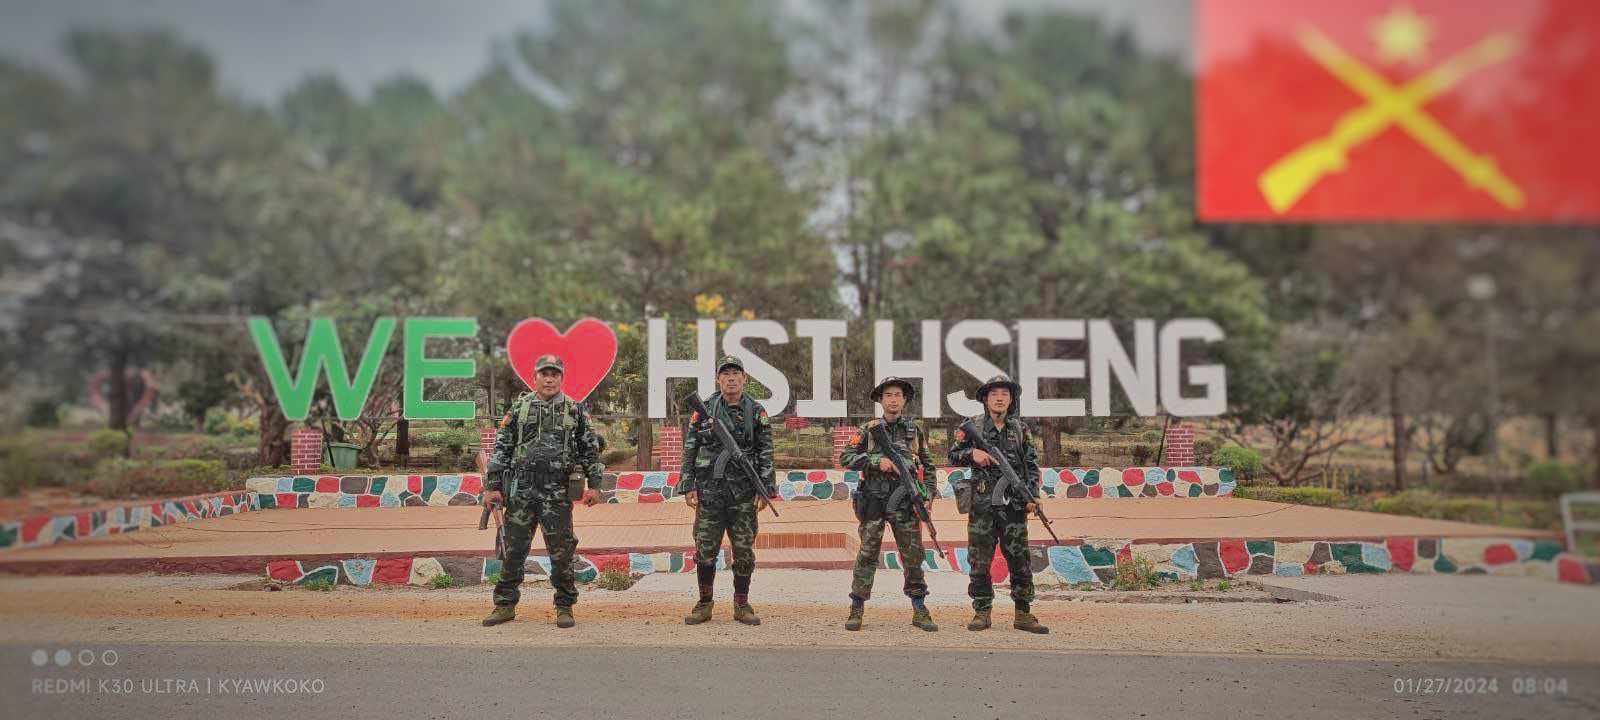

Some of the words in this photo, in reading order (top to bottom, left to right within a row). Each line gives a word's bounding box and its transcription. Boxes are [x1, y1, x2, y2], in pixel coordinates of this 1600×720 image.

[248, 316, 478, 421] WE
[647, 318, 848, 419] HSI
[874, 318, 1227, 418] HSENG
